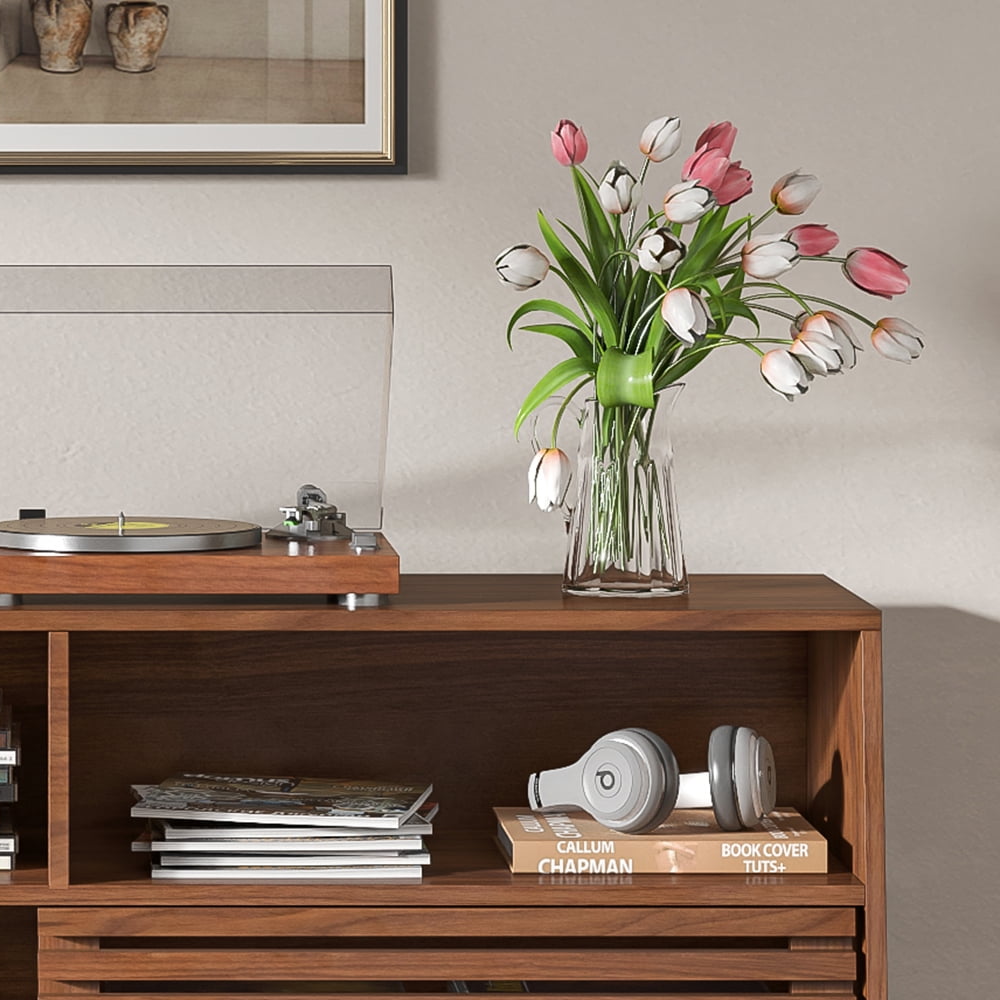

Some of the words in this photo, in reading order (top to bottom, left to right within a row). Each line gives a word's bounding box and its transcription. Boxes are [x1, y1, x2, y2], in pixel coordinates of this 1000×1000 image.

[556, 840, 615, 854] CALLUM
[720, 843, 761, 857] BOOK
[763, 843, 809, 857] COVER
[537, 858, 633, 875] CHAPMAN
[743, 860, 787, 873] TUTS+
